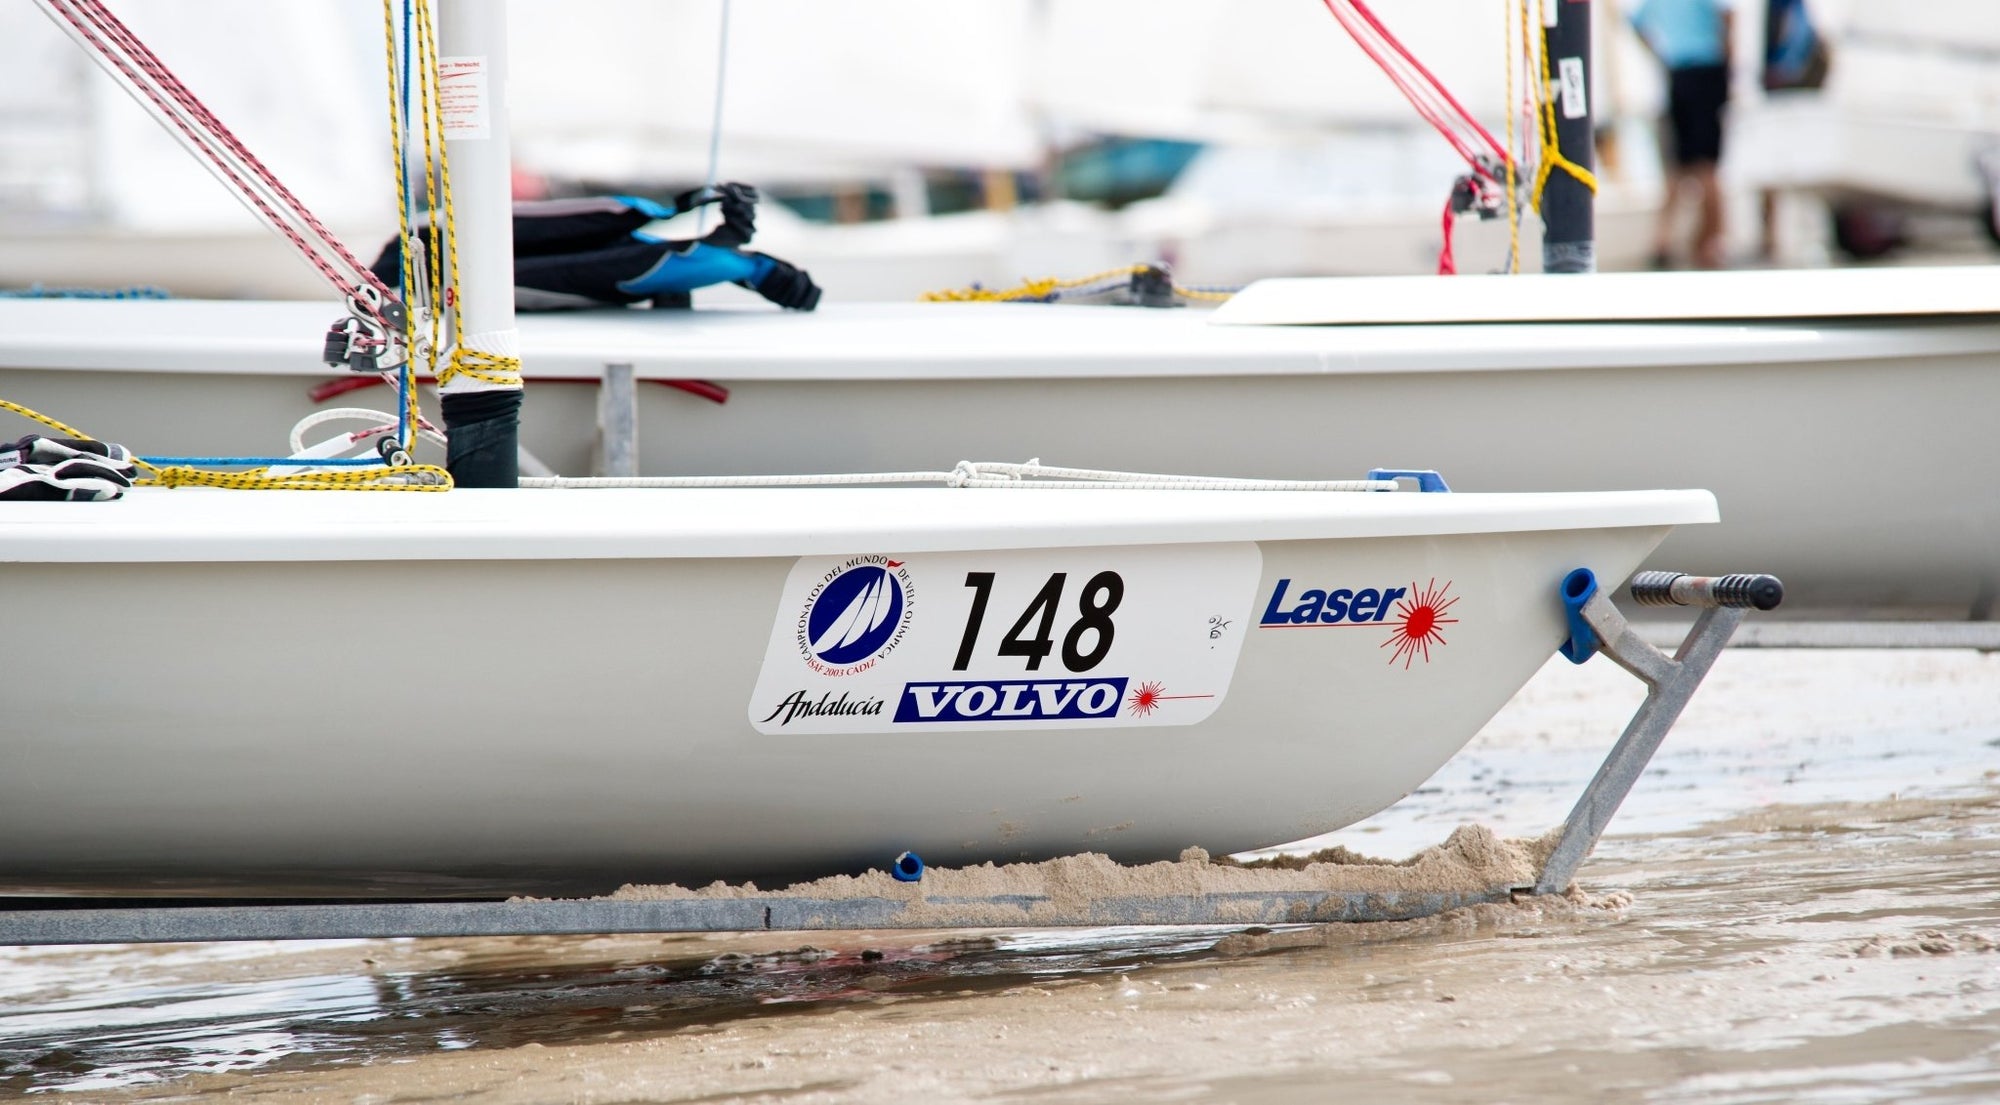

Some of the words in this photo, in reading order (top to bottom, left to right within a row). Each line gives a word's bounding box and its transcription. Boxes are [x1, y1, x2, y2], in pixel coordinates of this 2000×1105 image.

[797, 582, 824, 661] CAMPEONATOS
[824, 566, 843, 583] DEL
[846, 555, 888, 569] MUNDO
[897, 568, 911, 582] DE
[904, 581, 916, 607] VELA
[1260, 579, 1407, 624] Laser
[952, 570, 1125, 673] 148
[807, 659, 824, 672] ISAF
[824, 667, 844, 677] 2003
[908, 682, 1117, 718] VOLVO
